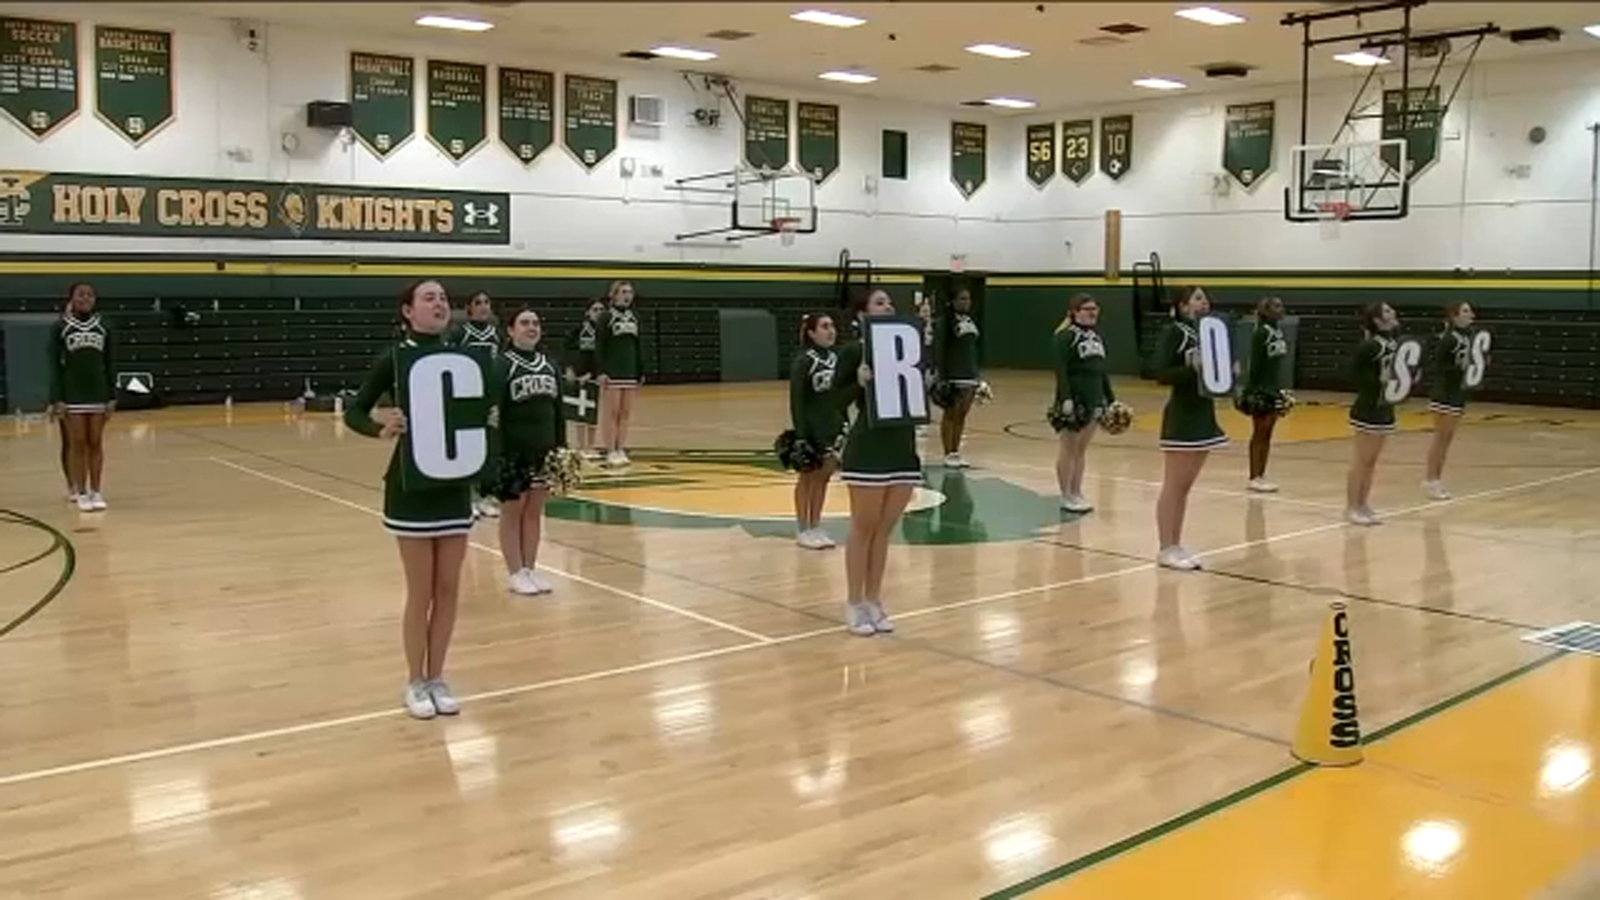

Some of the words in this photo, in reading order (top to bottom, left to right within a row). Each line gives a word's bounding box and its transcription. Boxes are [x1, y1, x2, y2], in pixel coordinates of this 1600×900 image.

[1029, 141, 1051, 161] 56
[1066, 137, 1089, 159] 23
[1108, 134, 1125, 156] 10
[53, 184, 146, 224] HOLY
[156, 189, 268, 229] CROSS
[316, 195, 454, 233] KNIGHTS
[870, 324, 927, 419] R
[1385, 341, 1421, 401] S
[1467, 331, 1491, 387] S
[409, 353, 487, 479] C
[1328, 612, 1361, 749] CROSS
